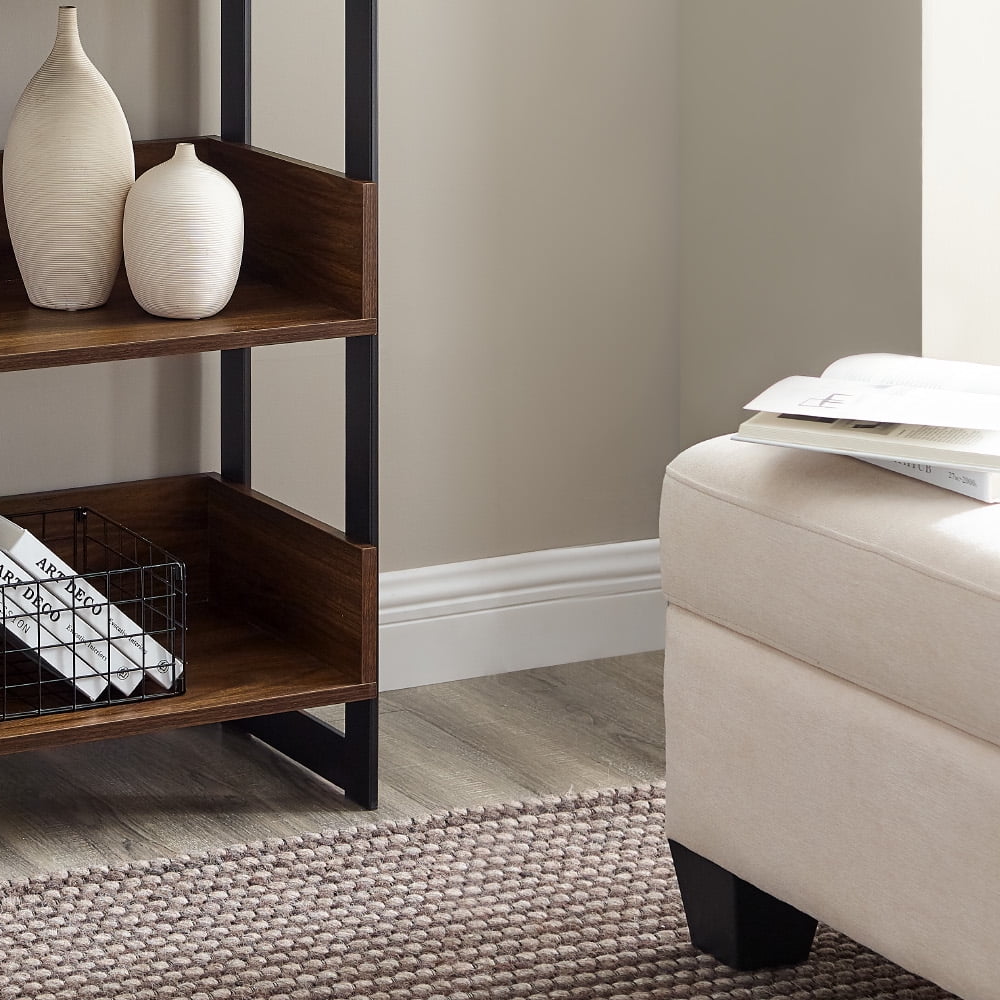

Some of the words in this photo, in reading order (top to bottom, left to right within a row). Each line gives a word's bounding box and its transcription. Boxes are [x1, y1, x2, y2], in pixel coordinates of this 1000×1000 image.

[22, 586, 61, 622] DECO
[35, 558, 67, 583] ART
[64, 579, 103, 616] DECO
